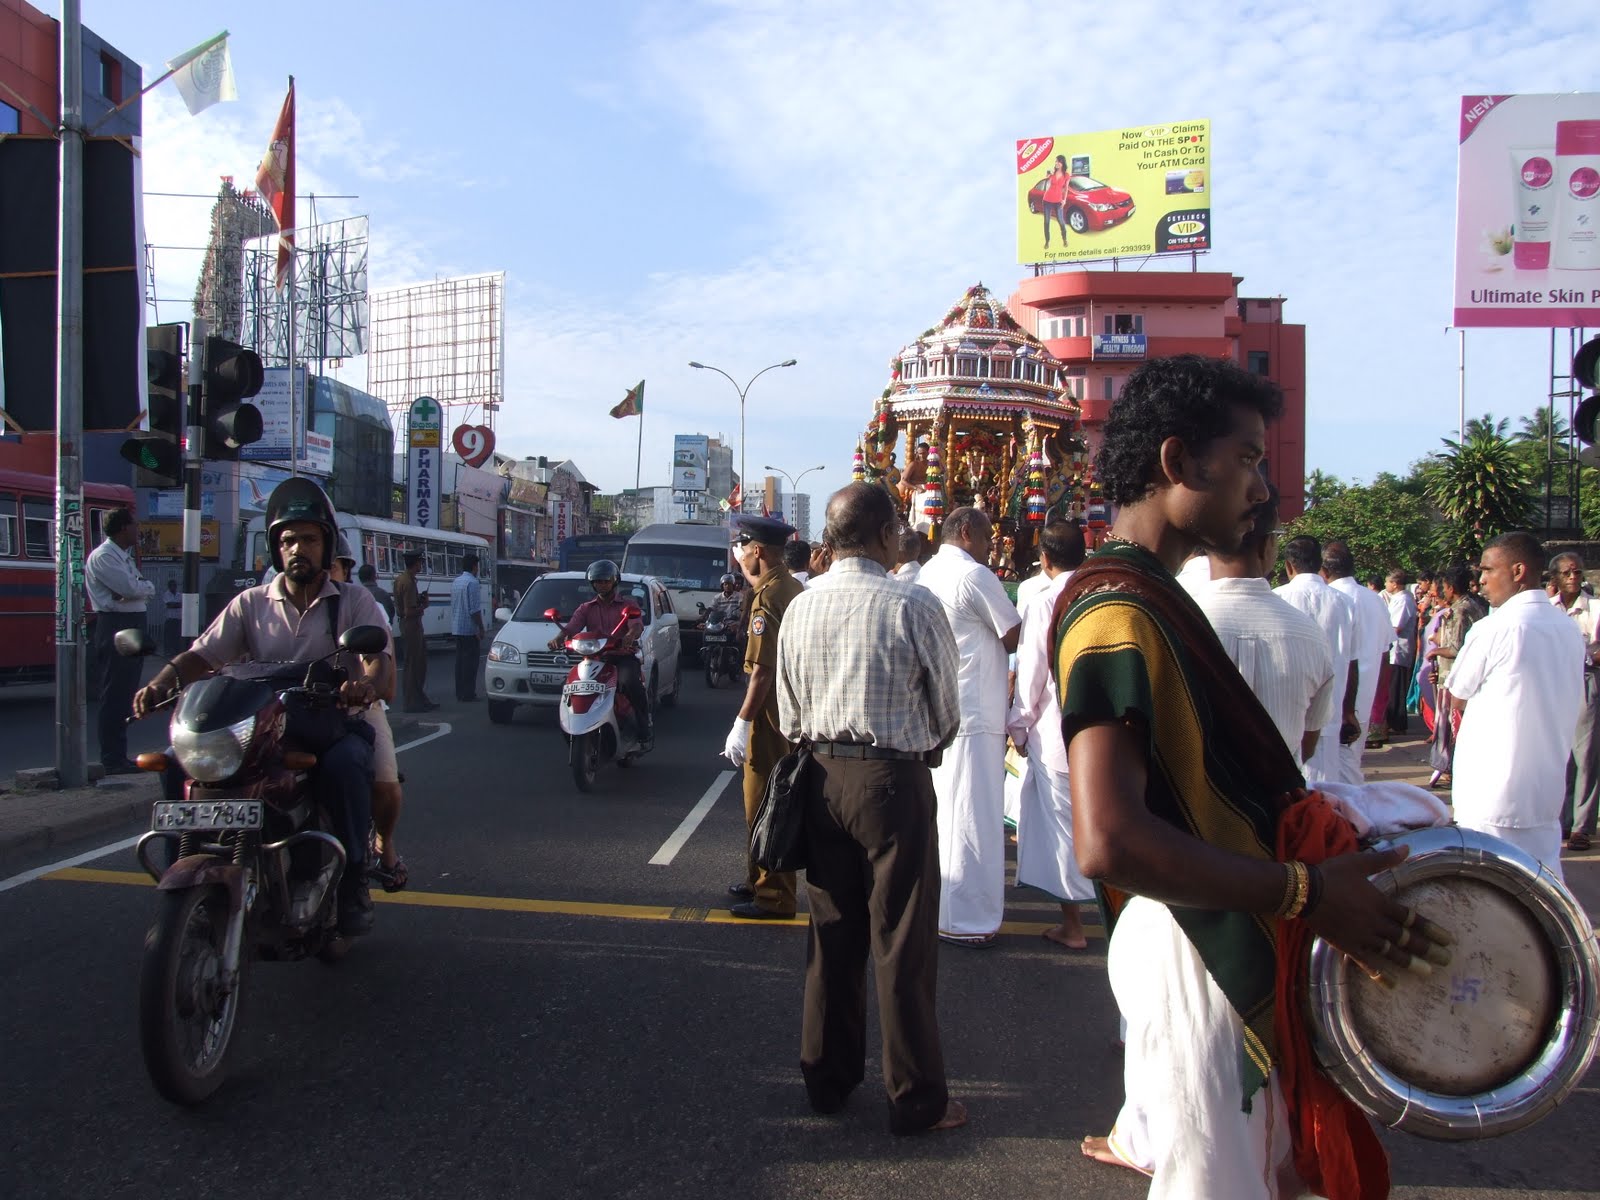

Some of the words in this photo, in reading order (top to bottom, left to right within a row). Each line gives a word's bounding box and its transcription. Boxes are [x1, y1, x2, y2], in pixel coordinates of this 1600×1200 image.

[1464, 96, 1495, 123] NEW
[1122, 131, 1142, 140] Now
[1150, 128, 1165, 137] VIP
[1172, 124, 1205, 134] Claims
[1119, 141, 1139, 151] Paid
[1141, 139, 1155, 148] ON
[1157, 138, 1175, 147] THE
[1143, 151, 1152, 159] In
[1154, 148, 1178, 158] Cash
[1180, 147, 1191, 155] Or
[1193, 145, 1205, 154] To
[1020, 139, 1052, 172] Innovation
[1137, 161, 1158, 171] Your
[1159, 159, 1180, 168] ATM
[1182, 156, 1205, 166] Card
[1177, 223, 1197, 234] VIP
[1044, 251, 1056, 259] For
[1078, 248, 1102, 256] details
[1104, 246, 1119, 255] call:
[1120, 244, 1151, 253] 2393939
[1470, 289, 1543, 303] Ultimate
[1548, 289, 1585, 303] Skin
[462, 429, 485, 461] 9
[416, 448, 431, 528] PHARMACY
